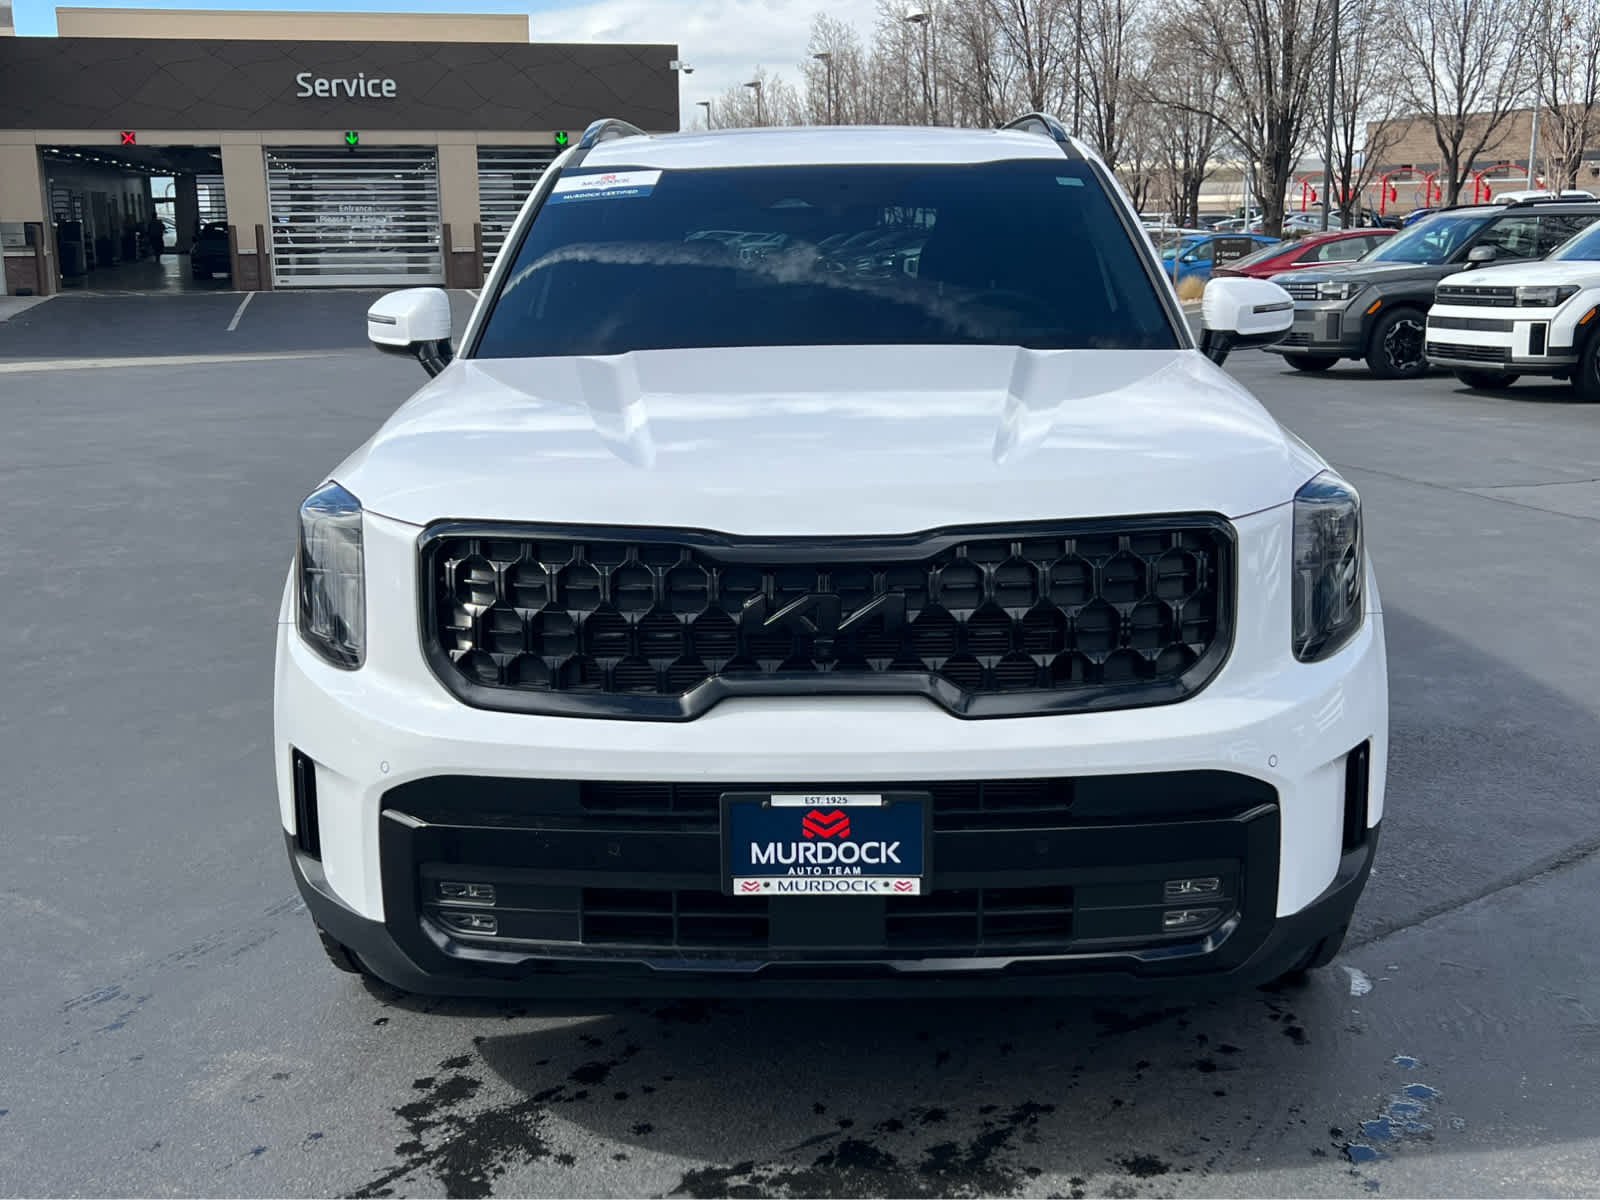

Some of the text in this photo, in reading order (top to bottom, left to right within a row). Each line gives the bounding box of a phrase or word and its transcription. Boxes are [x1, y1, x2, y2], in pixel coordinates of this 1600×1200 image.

[296, 72, 397, 97] Service
[563, 189, 639, 200] MURDOCK CERTIFIED
[338, 205, 373, 213] Entrance
[826, 796, 848, 804] 1925
[751, 841, 901, 864] MURDOCK
[787, 866, 862, 875] AUTO TEAM
[777, 880, 878, 892] MURDOCK
